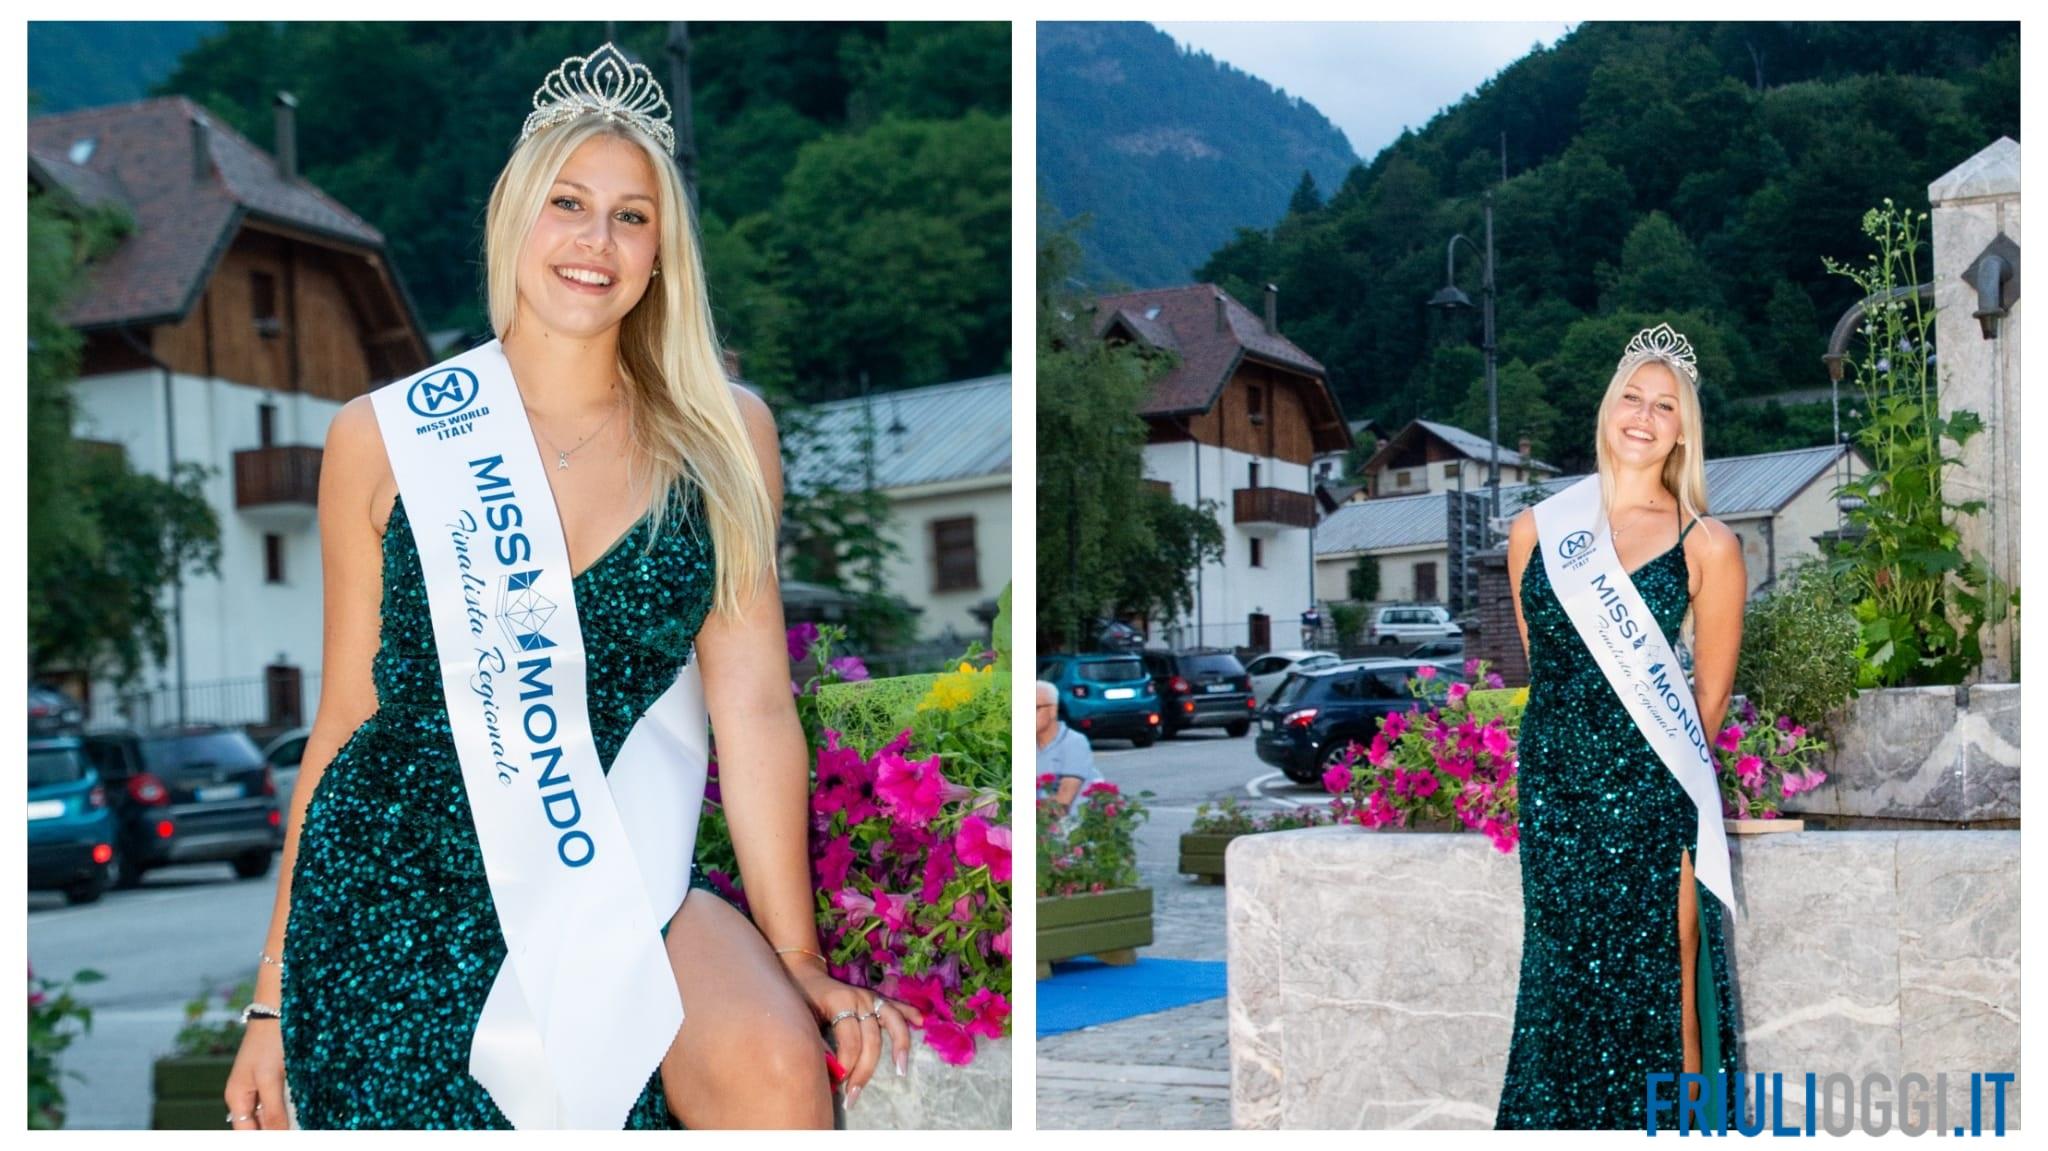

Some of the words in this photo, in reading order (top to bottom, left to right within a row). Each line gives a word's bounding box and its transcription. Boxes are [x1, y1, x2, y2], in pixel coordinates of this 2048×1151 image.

[416, 420, 447, 435] MISS
[448, 406, 490, 425] WORLD
[437, 422, 474, 441] ITALY
[1591, 574, 1639, 640] MISS
[445, 509, 489, 639] Finalista
[470, 646, 520, 789] Regionale
[469, 454, 531, 566] MISS
[517, 656, 595, 868] MONDO
